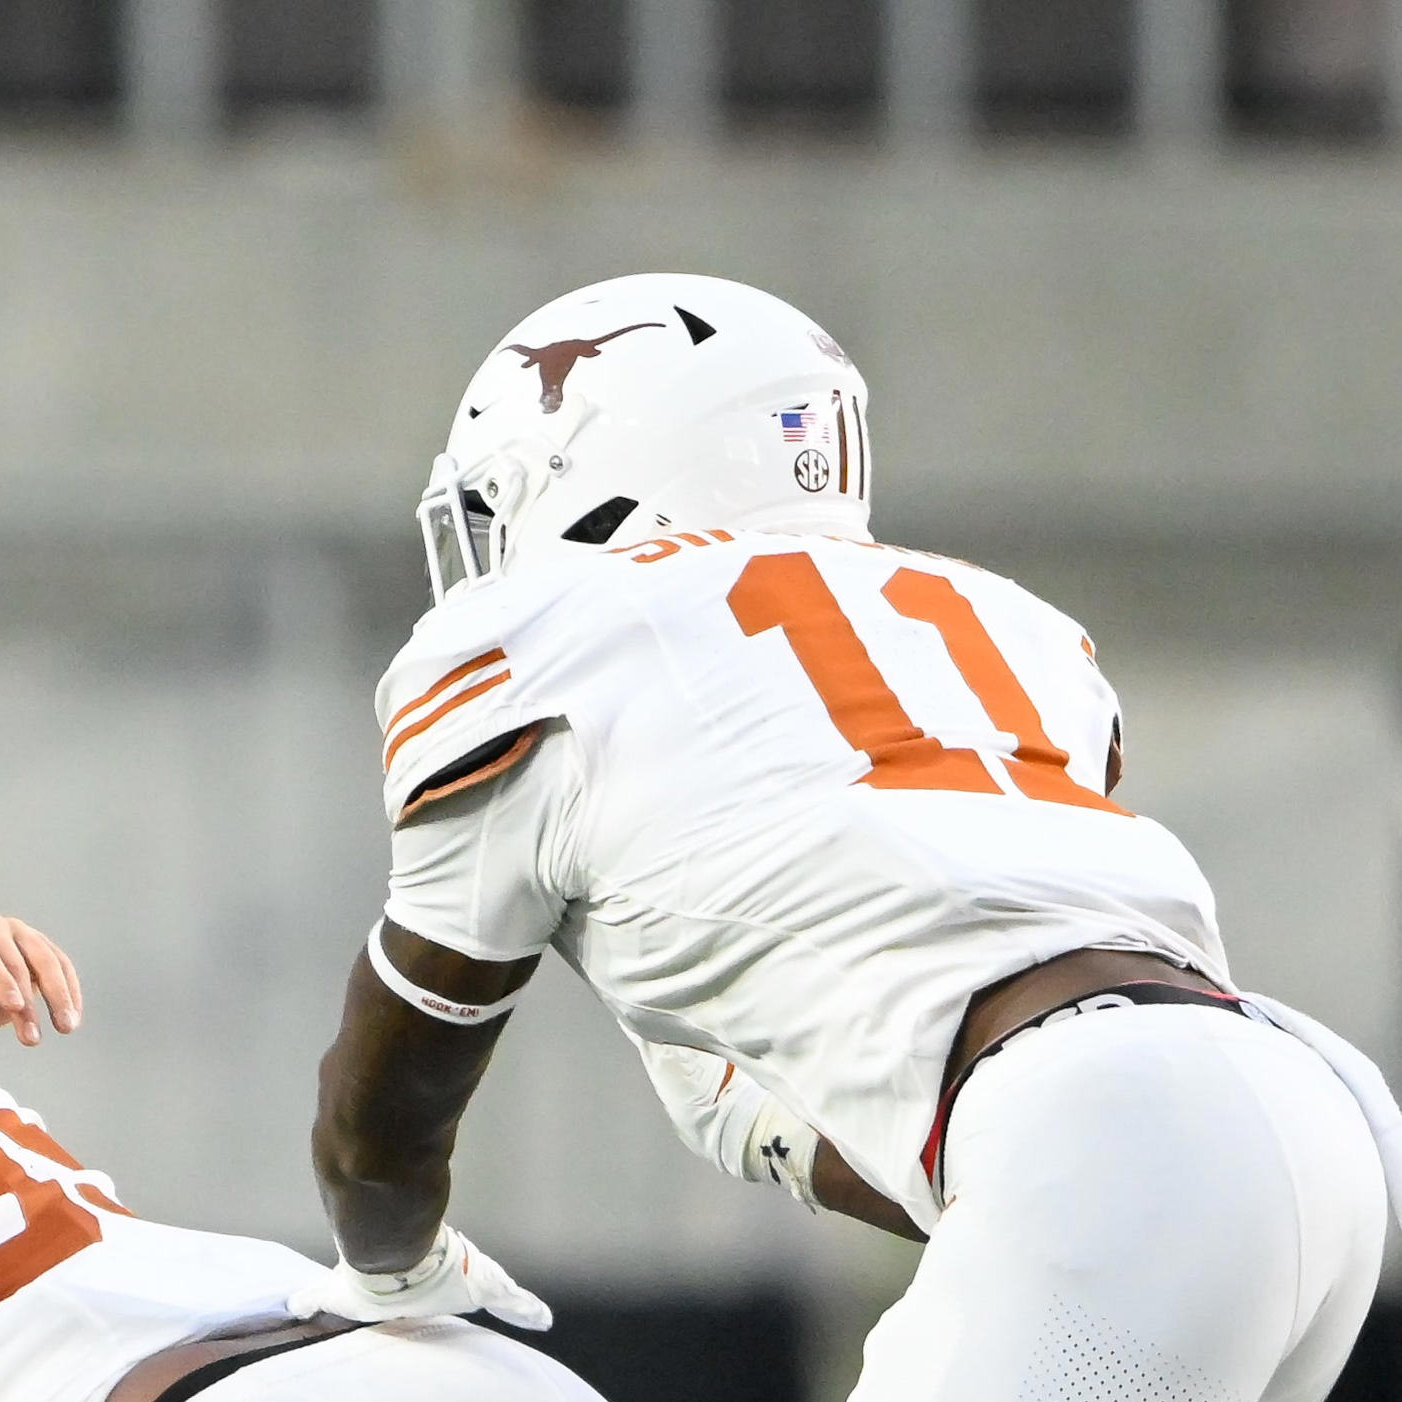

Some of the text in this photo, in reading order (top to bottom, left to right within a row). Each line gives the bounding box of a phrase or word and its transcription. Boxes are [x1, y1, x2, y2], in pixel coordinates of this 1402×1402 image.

[795, 449, 830, 492] SEC
[726, 551, 1137, 817] 11
[421, 996, 452, 1013] HOOK
